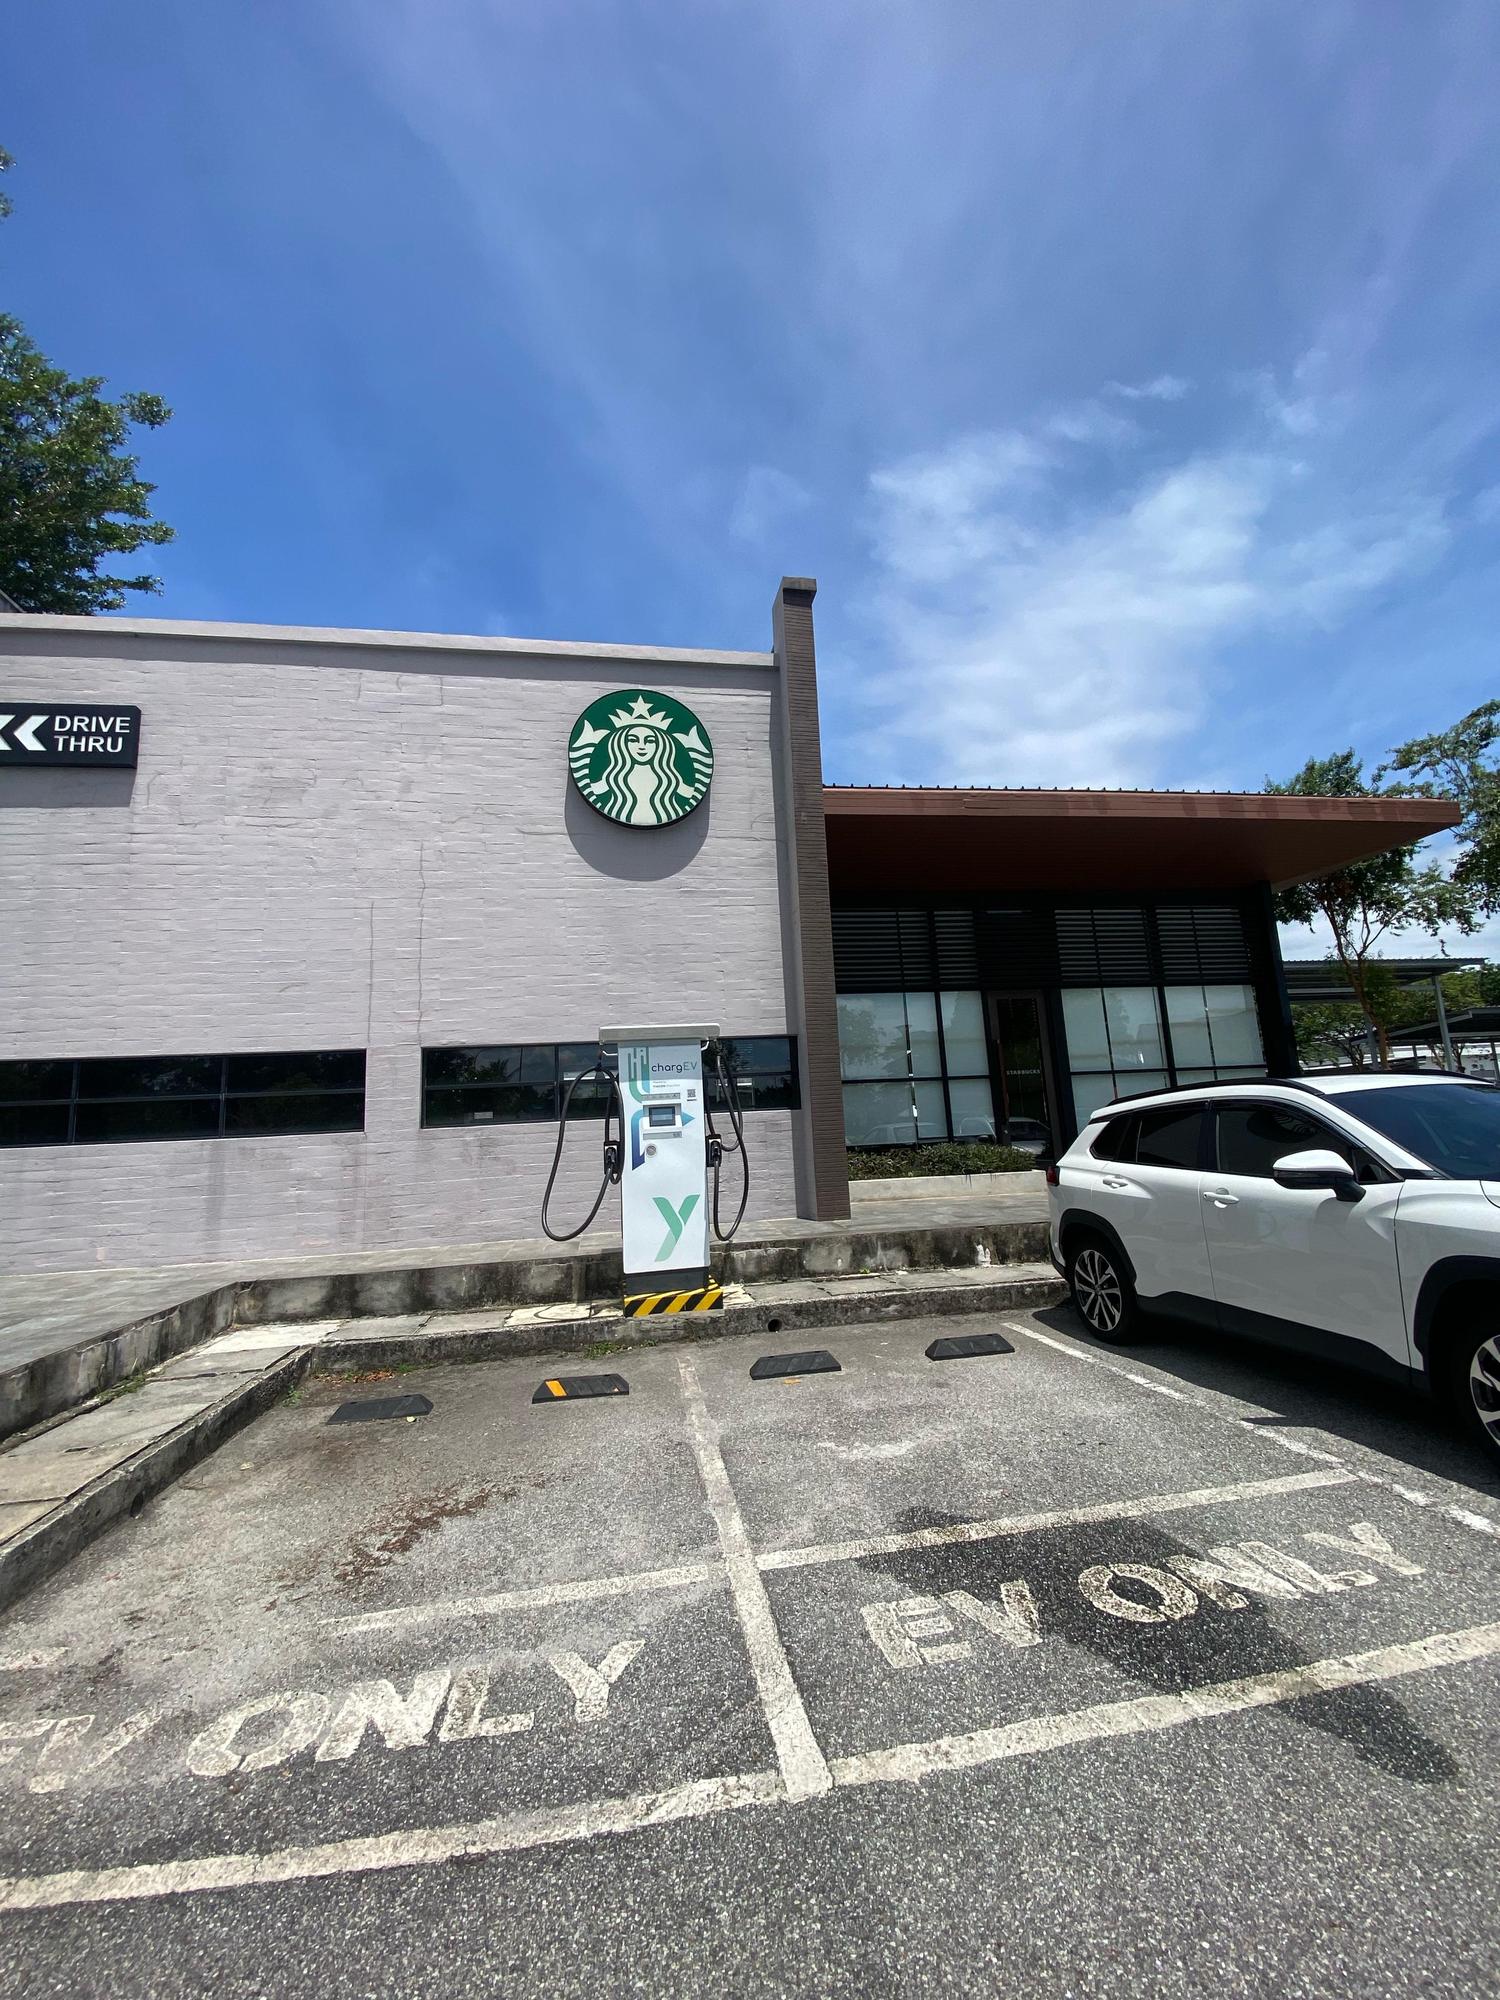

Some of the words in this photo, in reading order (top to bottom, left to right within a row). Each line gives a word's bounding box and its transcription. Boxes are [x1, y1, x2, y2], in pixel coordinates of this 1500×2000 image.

[54, 715, 131, 733] DRIVE
[54, 735, 123, 753] THRU
[651, 1061, 698, 1073] chargEV
[860, 1580, 1044, 1669] EV
[1078, 1523, 1426, 1623] ONLY
[186, 1640, 646, 1777] ONLY
